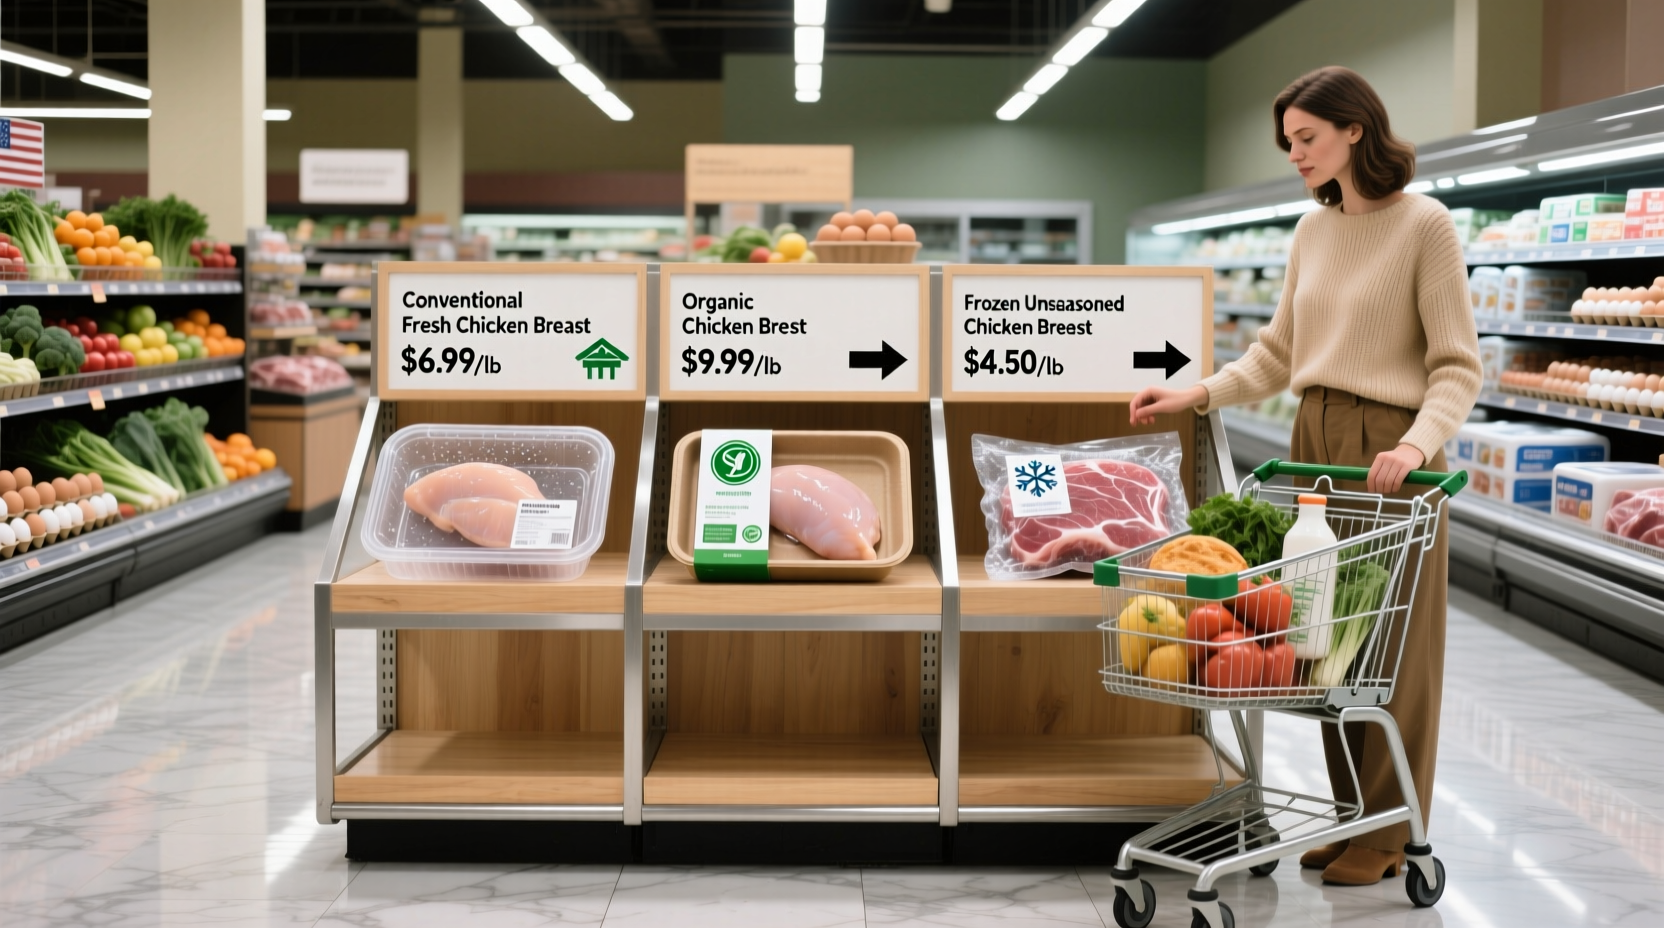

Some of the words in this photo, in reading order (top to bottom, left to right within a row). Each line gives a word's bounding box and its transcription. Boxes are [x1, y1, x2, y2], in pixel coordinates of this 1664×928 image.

[402, 290, 523, 309] Conventional
[682, 292, 754, 315] Organic
[964, 294, 1020, 312] Frozen
[402, 316, 452, 334] Fresh
[456, 316, 529, 334] Chicken
[533, 316, 591, 334] Breast
[682, 316, 754, 335] Chicken
[759, 317, 808, 335] Brest
[963, 318, 1033, 335] Chicken
[401, 344, 502, 377] $6.99/lb
[681, 346, 782, 378] $9.99/lb
[963, 346, 1064, 378] $4.50/lb
